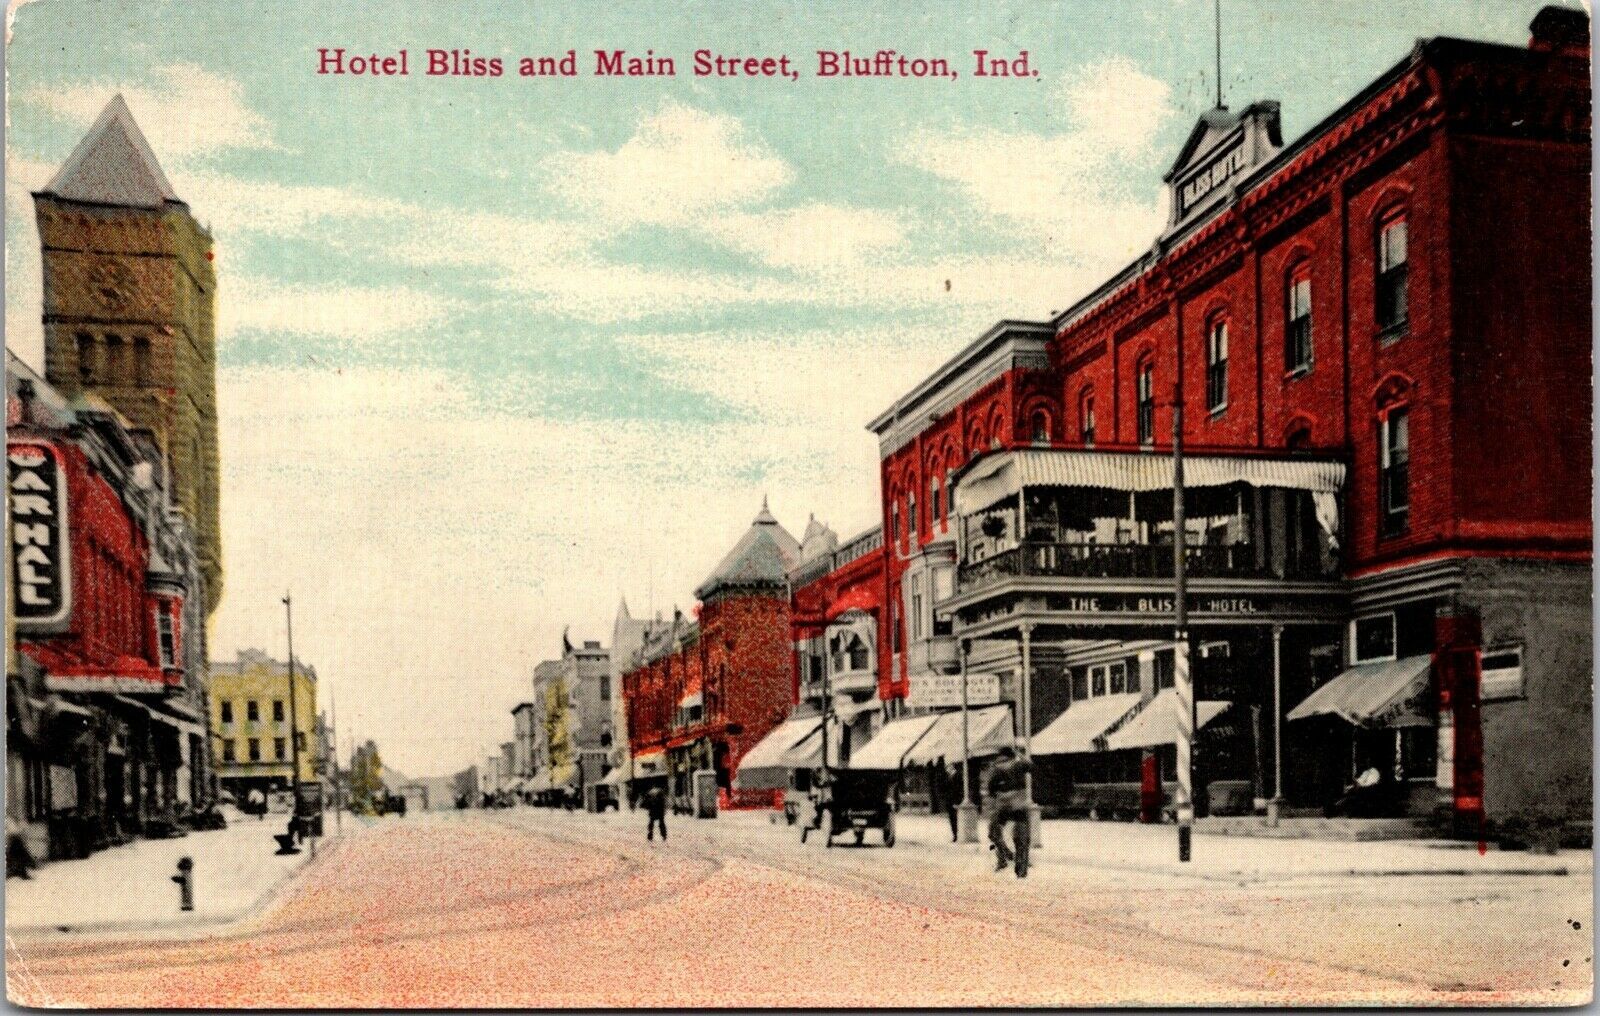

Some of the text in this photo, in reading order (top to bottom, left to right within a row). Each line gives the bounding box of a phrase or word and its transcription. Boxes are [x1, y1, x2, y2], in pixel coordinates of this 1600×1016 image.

[1070, 598, 1256, 613] THE BLIS HOTEL
